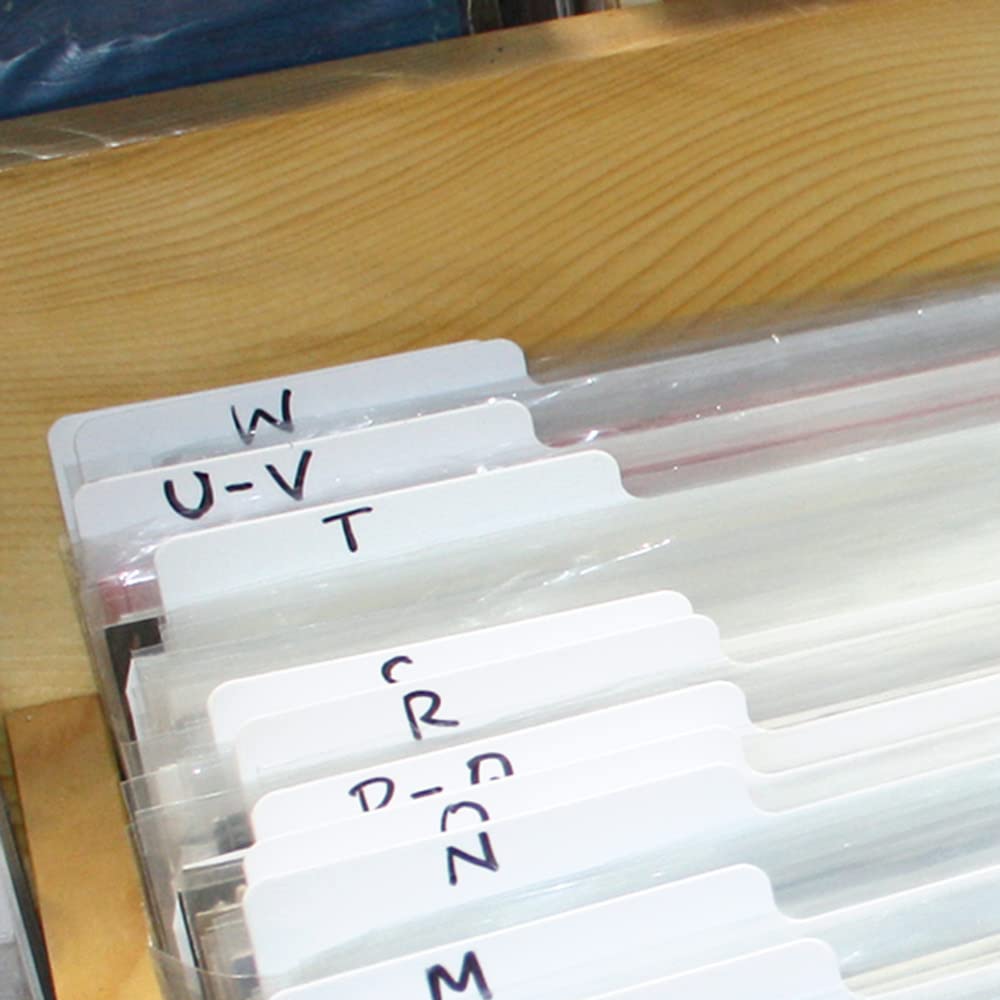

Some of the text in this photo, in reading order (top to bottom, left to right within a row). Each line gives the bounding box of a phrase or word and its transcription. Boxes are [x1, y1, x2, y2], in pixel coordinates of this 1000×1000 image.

[231, 388, 296, 446] W
[162, 449, 313, 521] U-V
[322, 506, 374, 553] T
[402, 689, 461, 742] R
[446, 831, 500, 887] N
